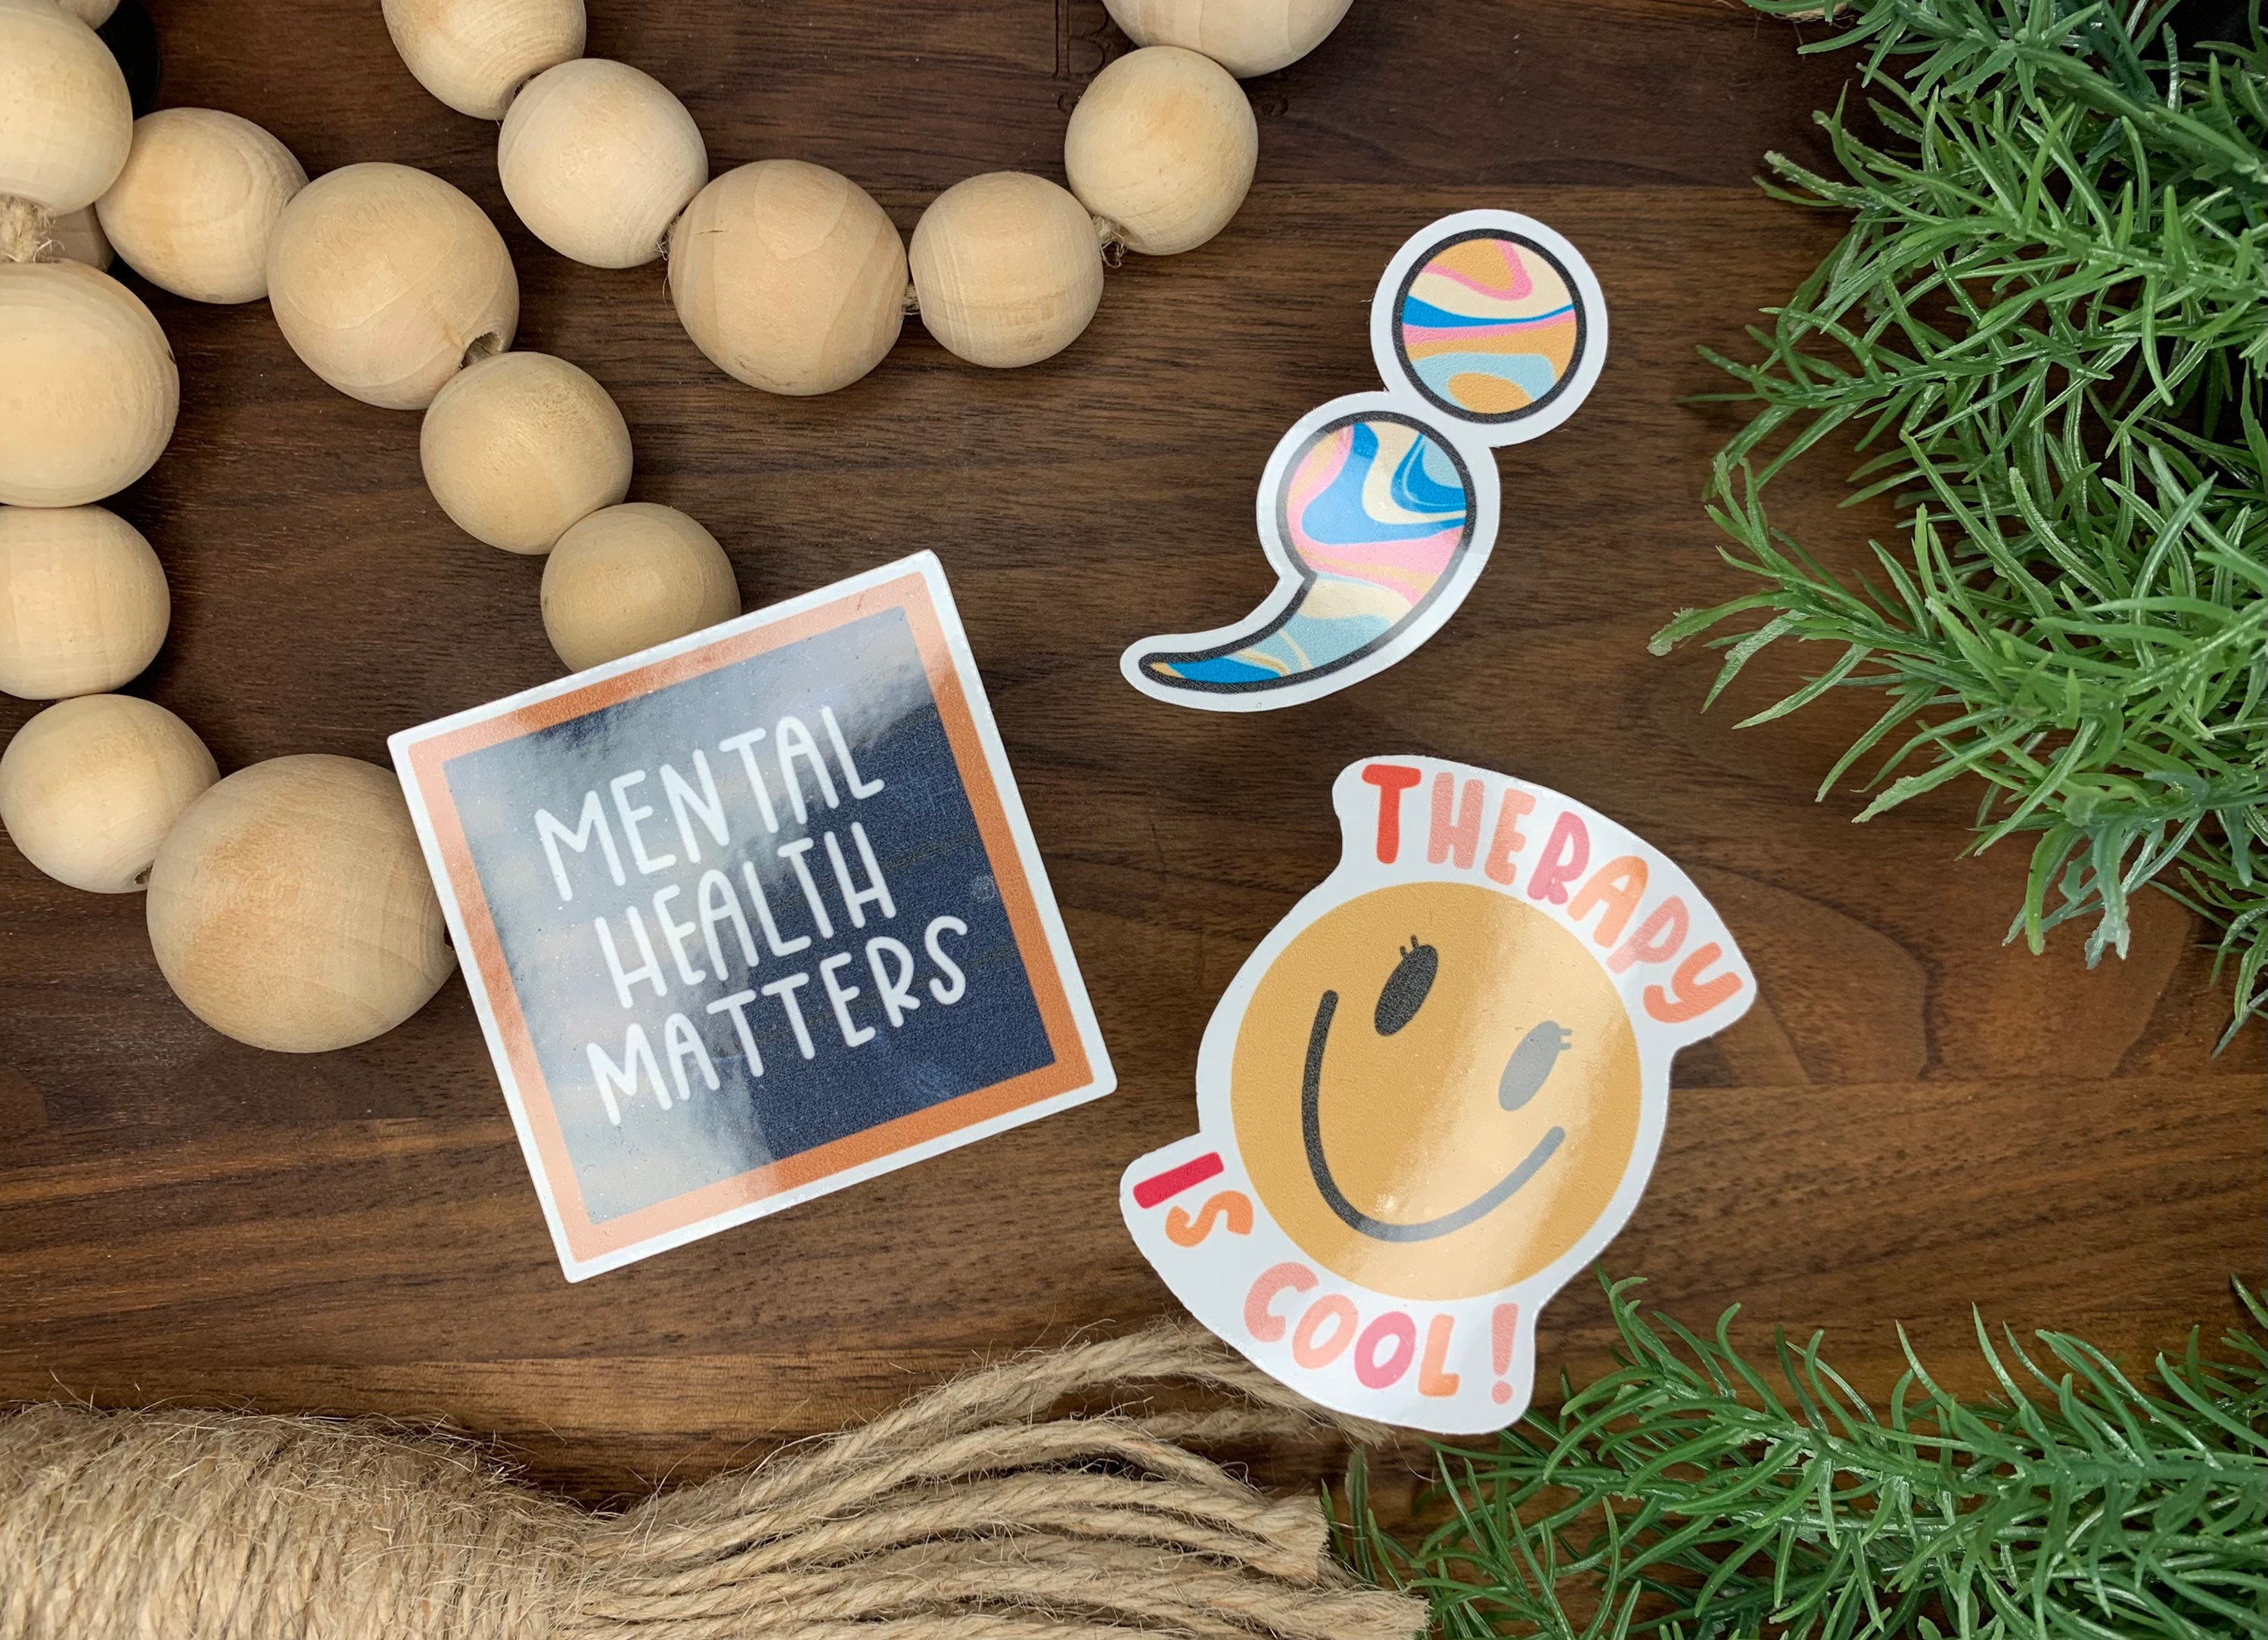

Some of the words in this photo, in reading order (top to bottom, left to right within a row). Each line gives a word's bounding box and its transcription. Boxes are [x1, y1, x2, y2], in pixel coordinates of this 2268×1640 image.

[534, 705, 884, 902] MENTAL
[1362, 765, 1744, 1023] THERAPY
[594, 822, 896, 1010] HEALTH
[585, 915, 968, 1126] MATTERS
[1132, 1151, 1254, 1247] IS
